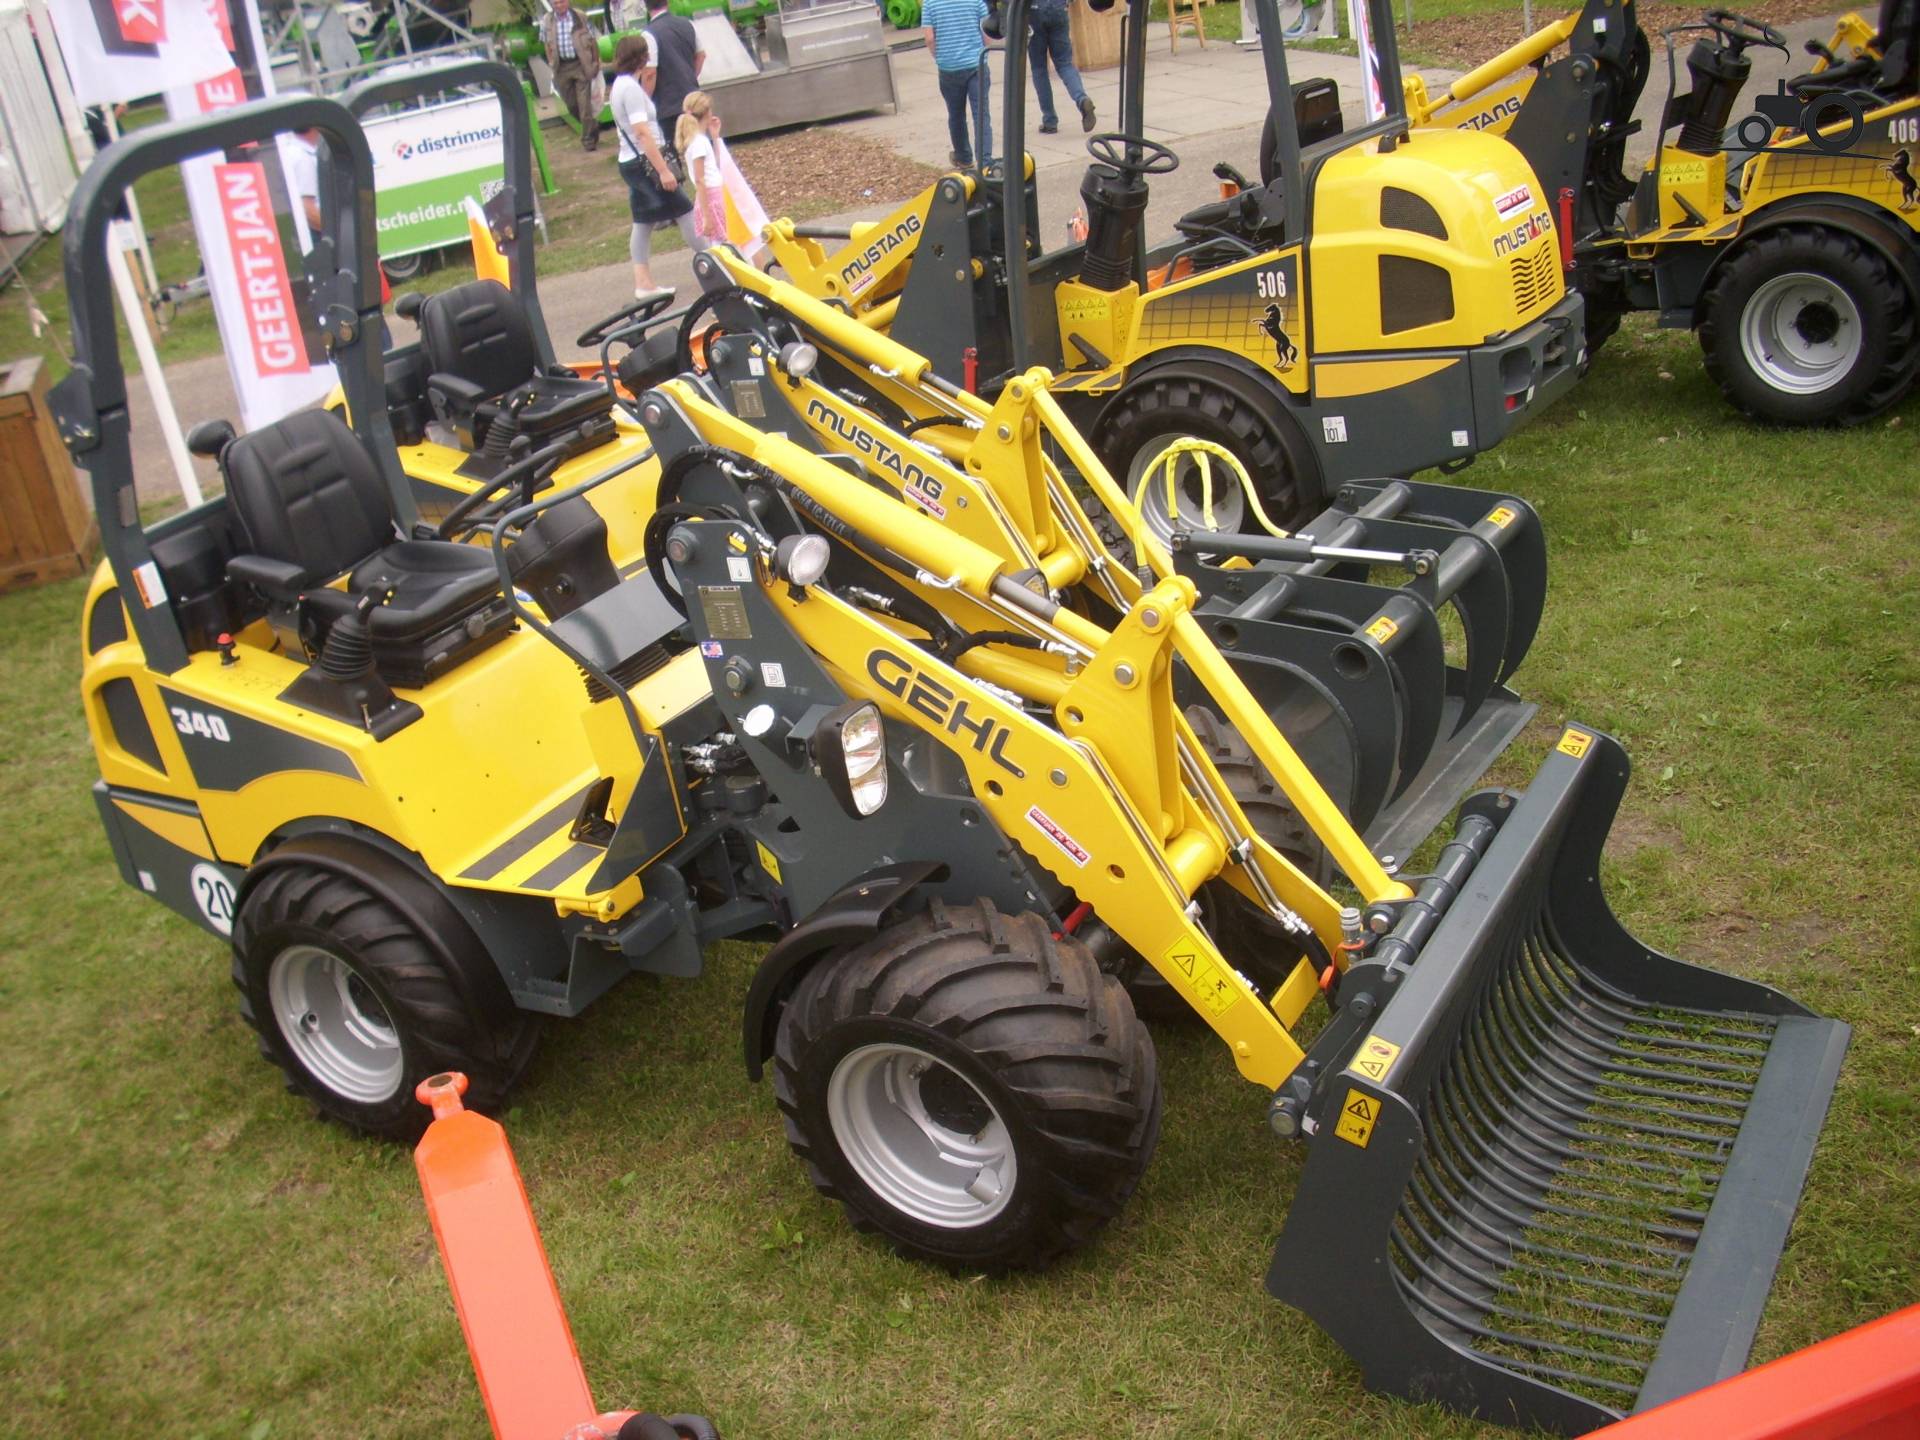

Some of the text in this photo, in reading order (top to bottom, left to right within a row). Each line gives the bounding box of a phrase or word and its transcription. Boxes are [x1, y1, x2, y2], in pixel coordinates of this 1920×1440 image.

[416, 126, 502, 154] distrimex
[1888, 118, 1918, 144] 406
[842, 215, 921, 284] MUSTANG
[1494, 212, 1551, 257] MUSTANG
[224, 172, 297, 369] GEERT-JAN
[1256, 271, 1287, 298] 506
[807, 399, 943, 500] MUSTANG
[1325, 427, 1340, 442] 101
[170, 706, 231, 742] 340
[866, 649, 1025, 779] GEHL
[198, 877, 235, 921] 20
